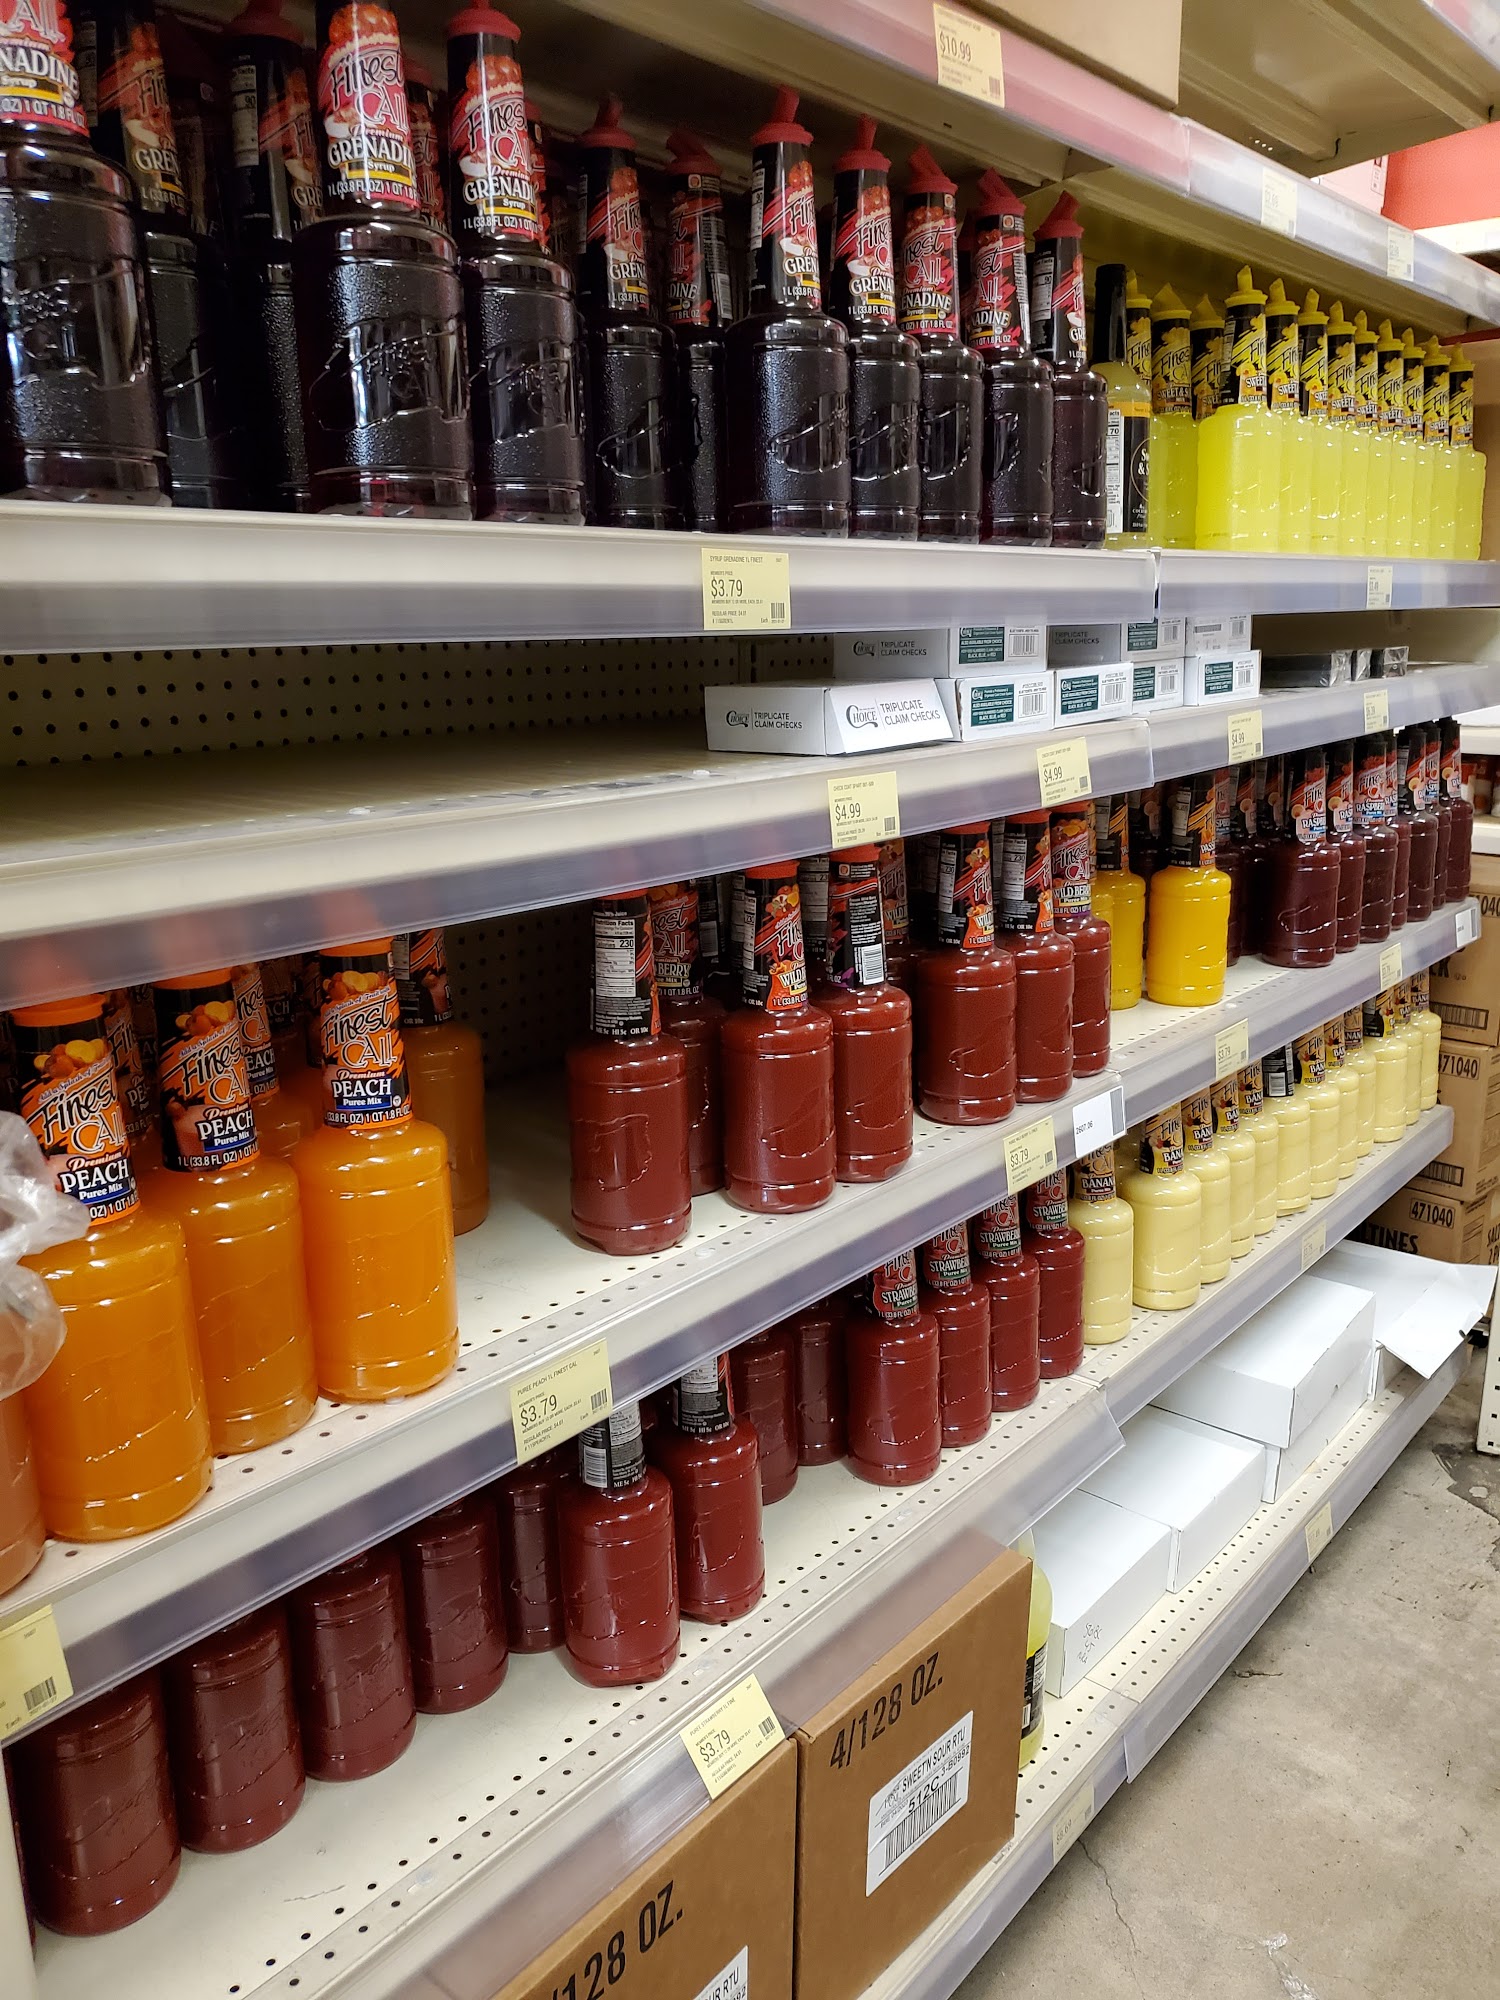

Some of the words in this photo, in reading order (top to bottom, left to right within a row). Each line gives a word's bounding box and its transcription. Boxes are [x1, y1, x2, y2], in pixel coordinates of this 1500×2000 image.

[940, 30, 972, 62] $10.99
[0, 47, 79, 95] NADINE
[468, 99, 527, 152] Fines
[329, 137, 417, 169] GRENADIN
[367, 160, 395, 172] Syrup
[503, 198, 525, 209] Syrup
[669, 282, 698, 300] DINE
[850, 276, 895, 296] GRENA
[902, 293, 951, 312] ENADINE
[711, 576, 743, 599] $3.79
[880, 648, 900, 656] CLAIM
[901, 648, 927, 656] CHECKS
[754, 712, 790, 721] TRIPLICATE
[754, 720, 775, 729] CLAIM
[776, 721, 802, 729] CHECKS
[846, 704, 879, 729] CHOICE
[879, 700, 924, 713] TRIPLICATE
[884, 714, 909, 726] CLAIM
[910, 710, 941, 723] CHECKS
[1044, 766, 1063, 783] $4.99
[835, 803, 861, 822] $4.99
[619, 939, 634, 949] 230
[658, 962, 691, 977] BERRY
[322, 996, 399, 1054] Finest
[341, 1032, 398, 1069] CALL
[175, 1029, 242, 1097] Fines
[336, 1069, 386, 1081] Premium
[333, 1079, 391, 1098] PEACH
[203, 1102, 249, 1120] Premium
[342, 1098, 366, 1107] Puree
[367, 1097, 382, 1106] Mix
[198, 1109, 254, 1140] PEACH
[340, 1112, 348, 1123] FL
[350, 1112, 364, 1124] OZ)
[372, 1111, 383, 1122] QT
[385, 1109, 394, 1121] 1.8
[71, 1107, 127, 1153] CALL
[1075, 1120, 1094, 1135] 2607.06
[214, 1136, 238, 1147] Puree
[238, 1131, 250, 1142] Mix
[67, 1151, 122, 1172] Premium
[190, 1154, 210, 1168] (33.8
[212, 1153, 222, 1166] FL
[223, 1149, 238, 1164] OZ)
[1010, 1148, 1029, 1168] $3.79
[59, 1159, 129, 1194] PEACH
[79, 1188, 108, 1201] Puree
[109, 1182, 123, 1194] Mix
[1412, 1201, 1453, 1228] 471040
[517, 1384, 531, 1396] PUREE
[533, 1377, 547, 1390] PEACH
[554, 1365, 569, 1378] FINEST
[569, 1361, 577, 1370] CAL
[520, 1394, 558, 1427] $3.79
[613, 1480, 623, 1488] ME
[830, 1682, 903, 1770] 4/128
[911, 1651, 943, 1706] OZ.
[700, 1729, 731, 1763] $3.79
[932, 1739, 951, 1766] SOUR
[952, 1726, 966, 1747] RTU
[908, 1776, 940, 1814] 512C
[639, 1880, 683, 1954] OZ.
[723, 1965, 739, 1998] RTU
